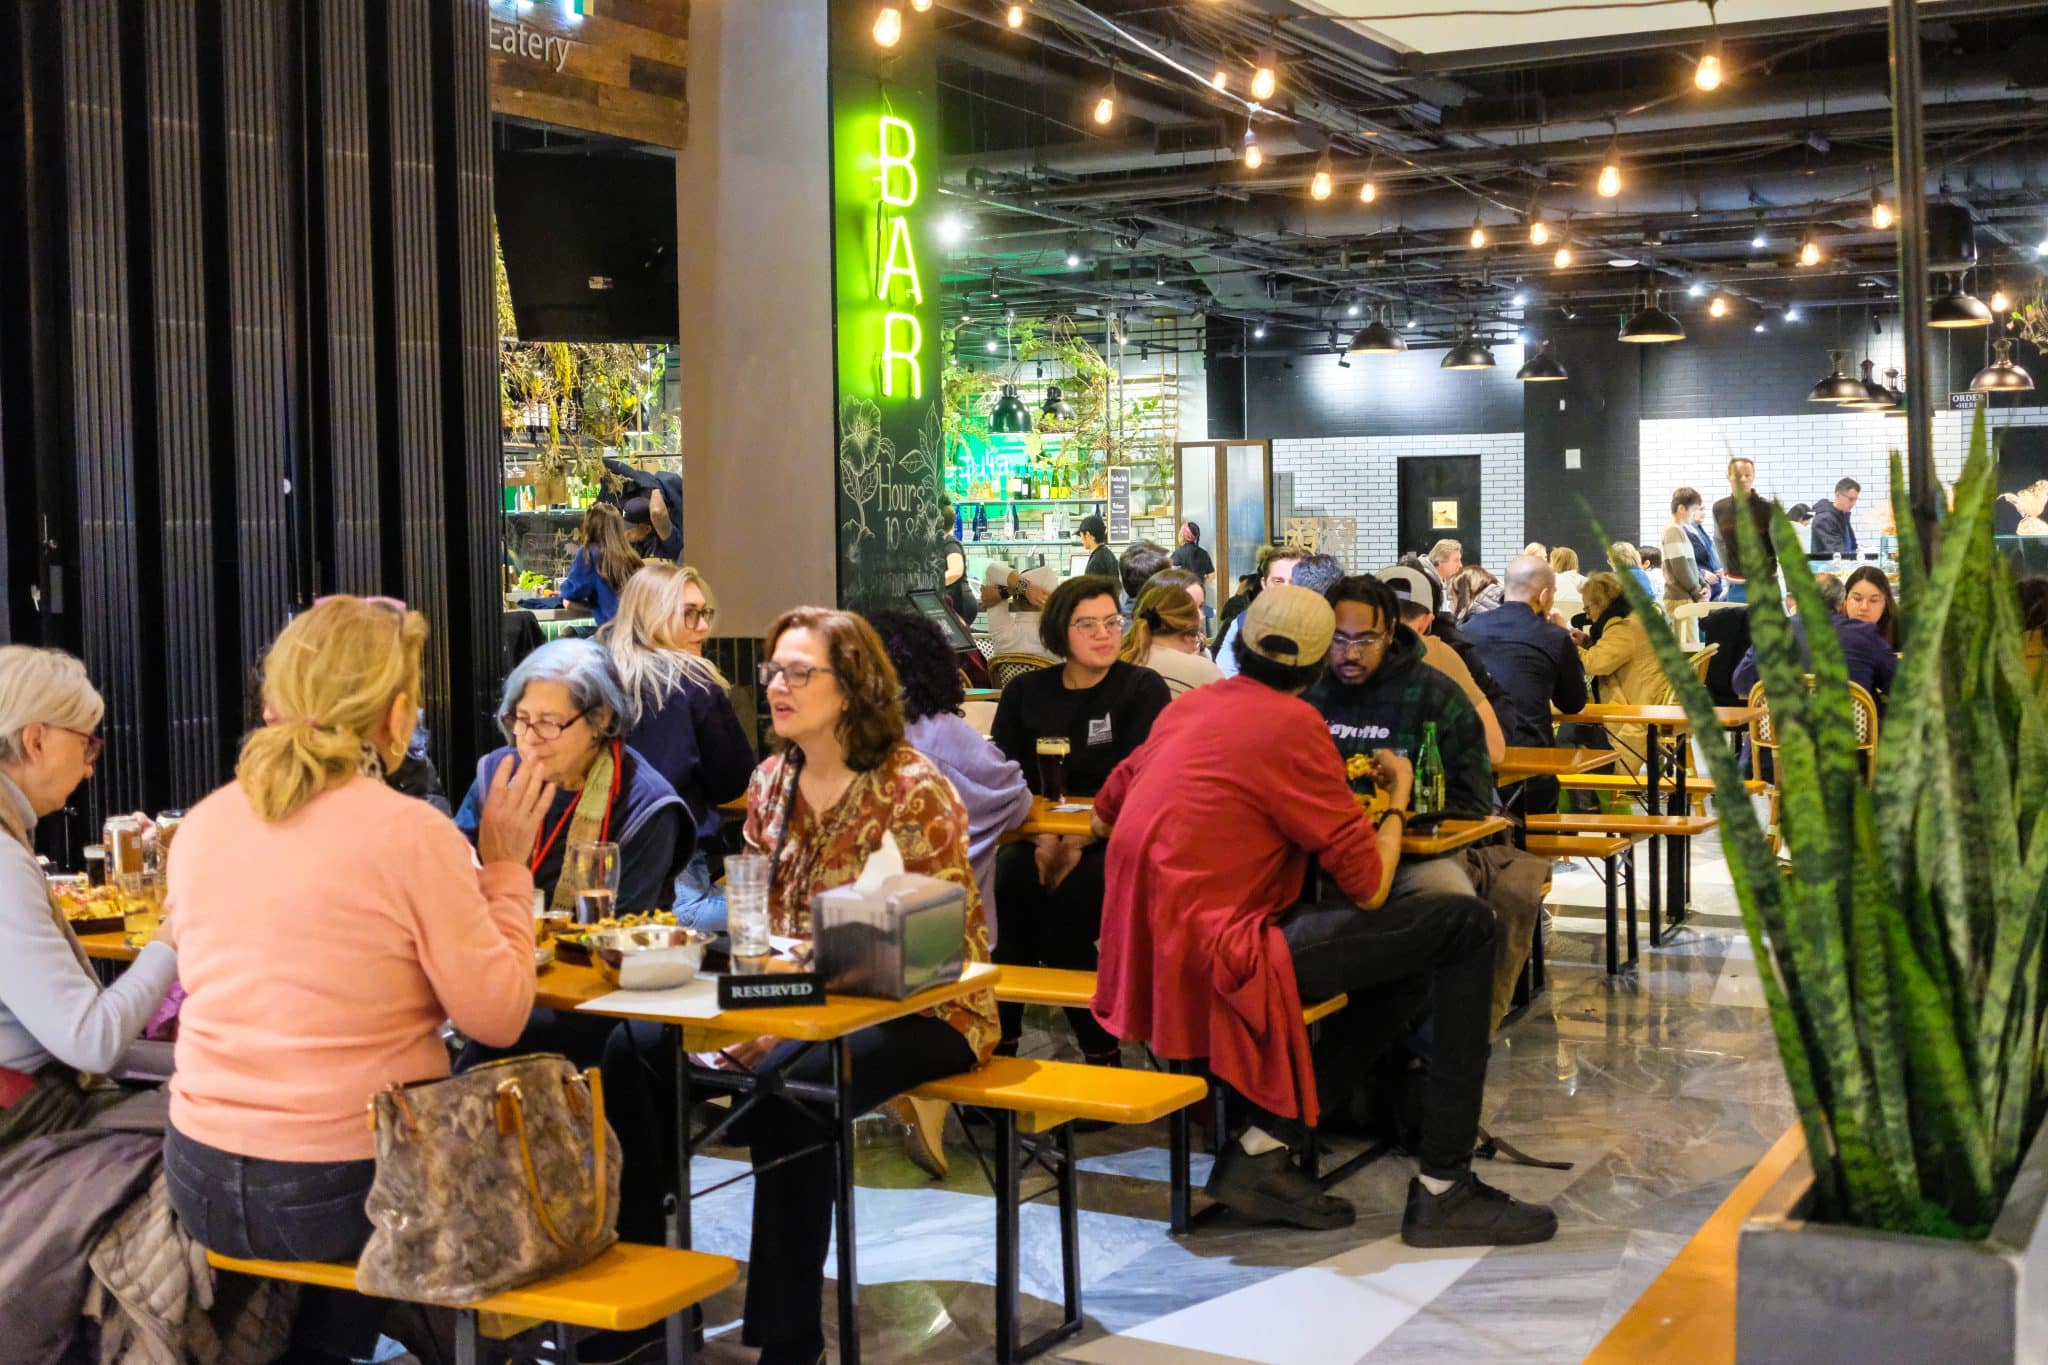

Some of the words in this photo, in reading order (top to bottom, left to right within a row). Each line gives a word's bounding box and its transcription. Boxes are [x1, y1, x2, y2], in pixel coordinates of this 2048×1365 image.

[489, 14, 570, 72] Eatery
[879, 116, 922, 399] BAR
[877, 463, 925, 512] Hours
[731, 983, 813, 998] RESERVED
